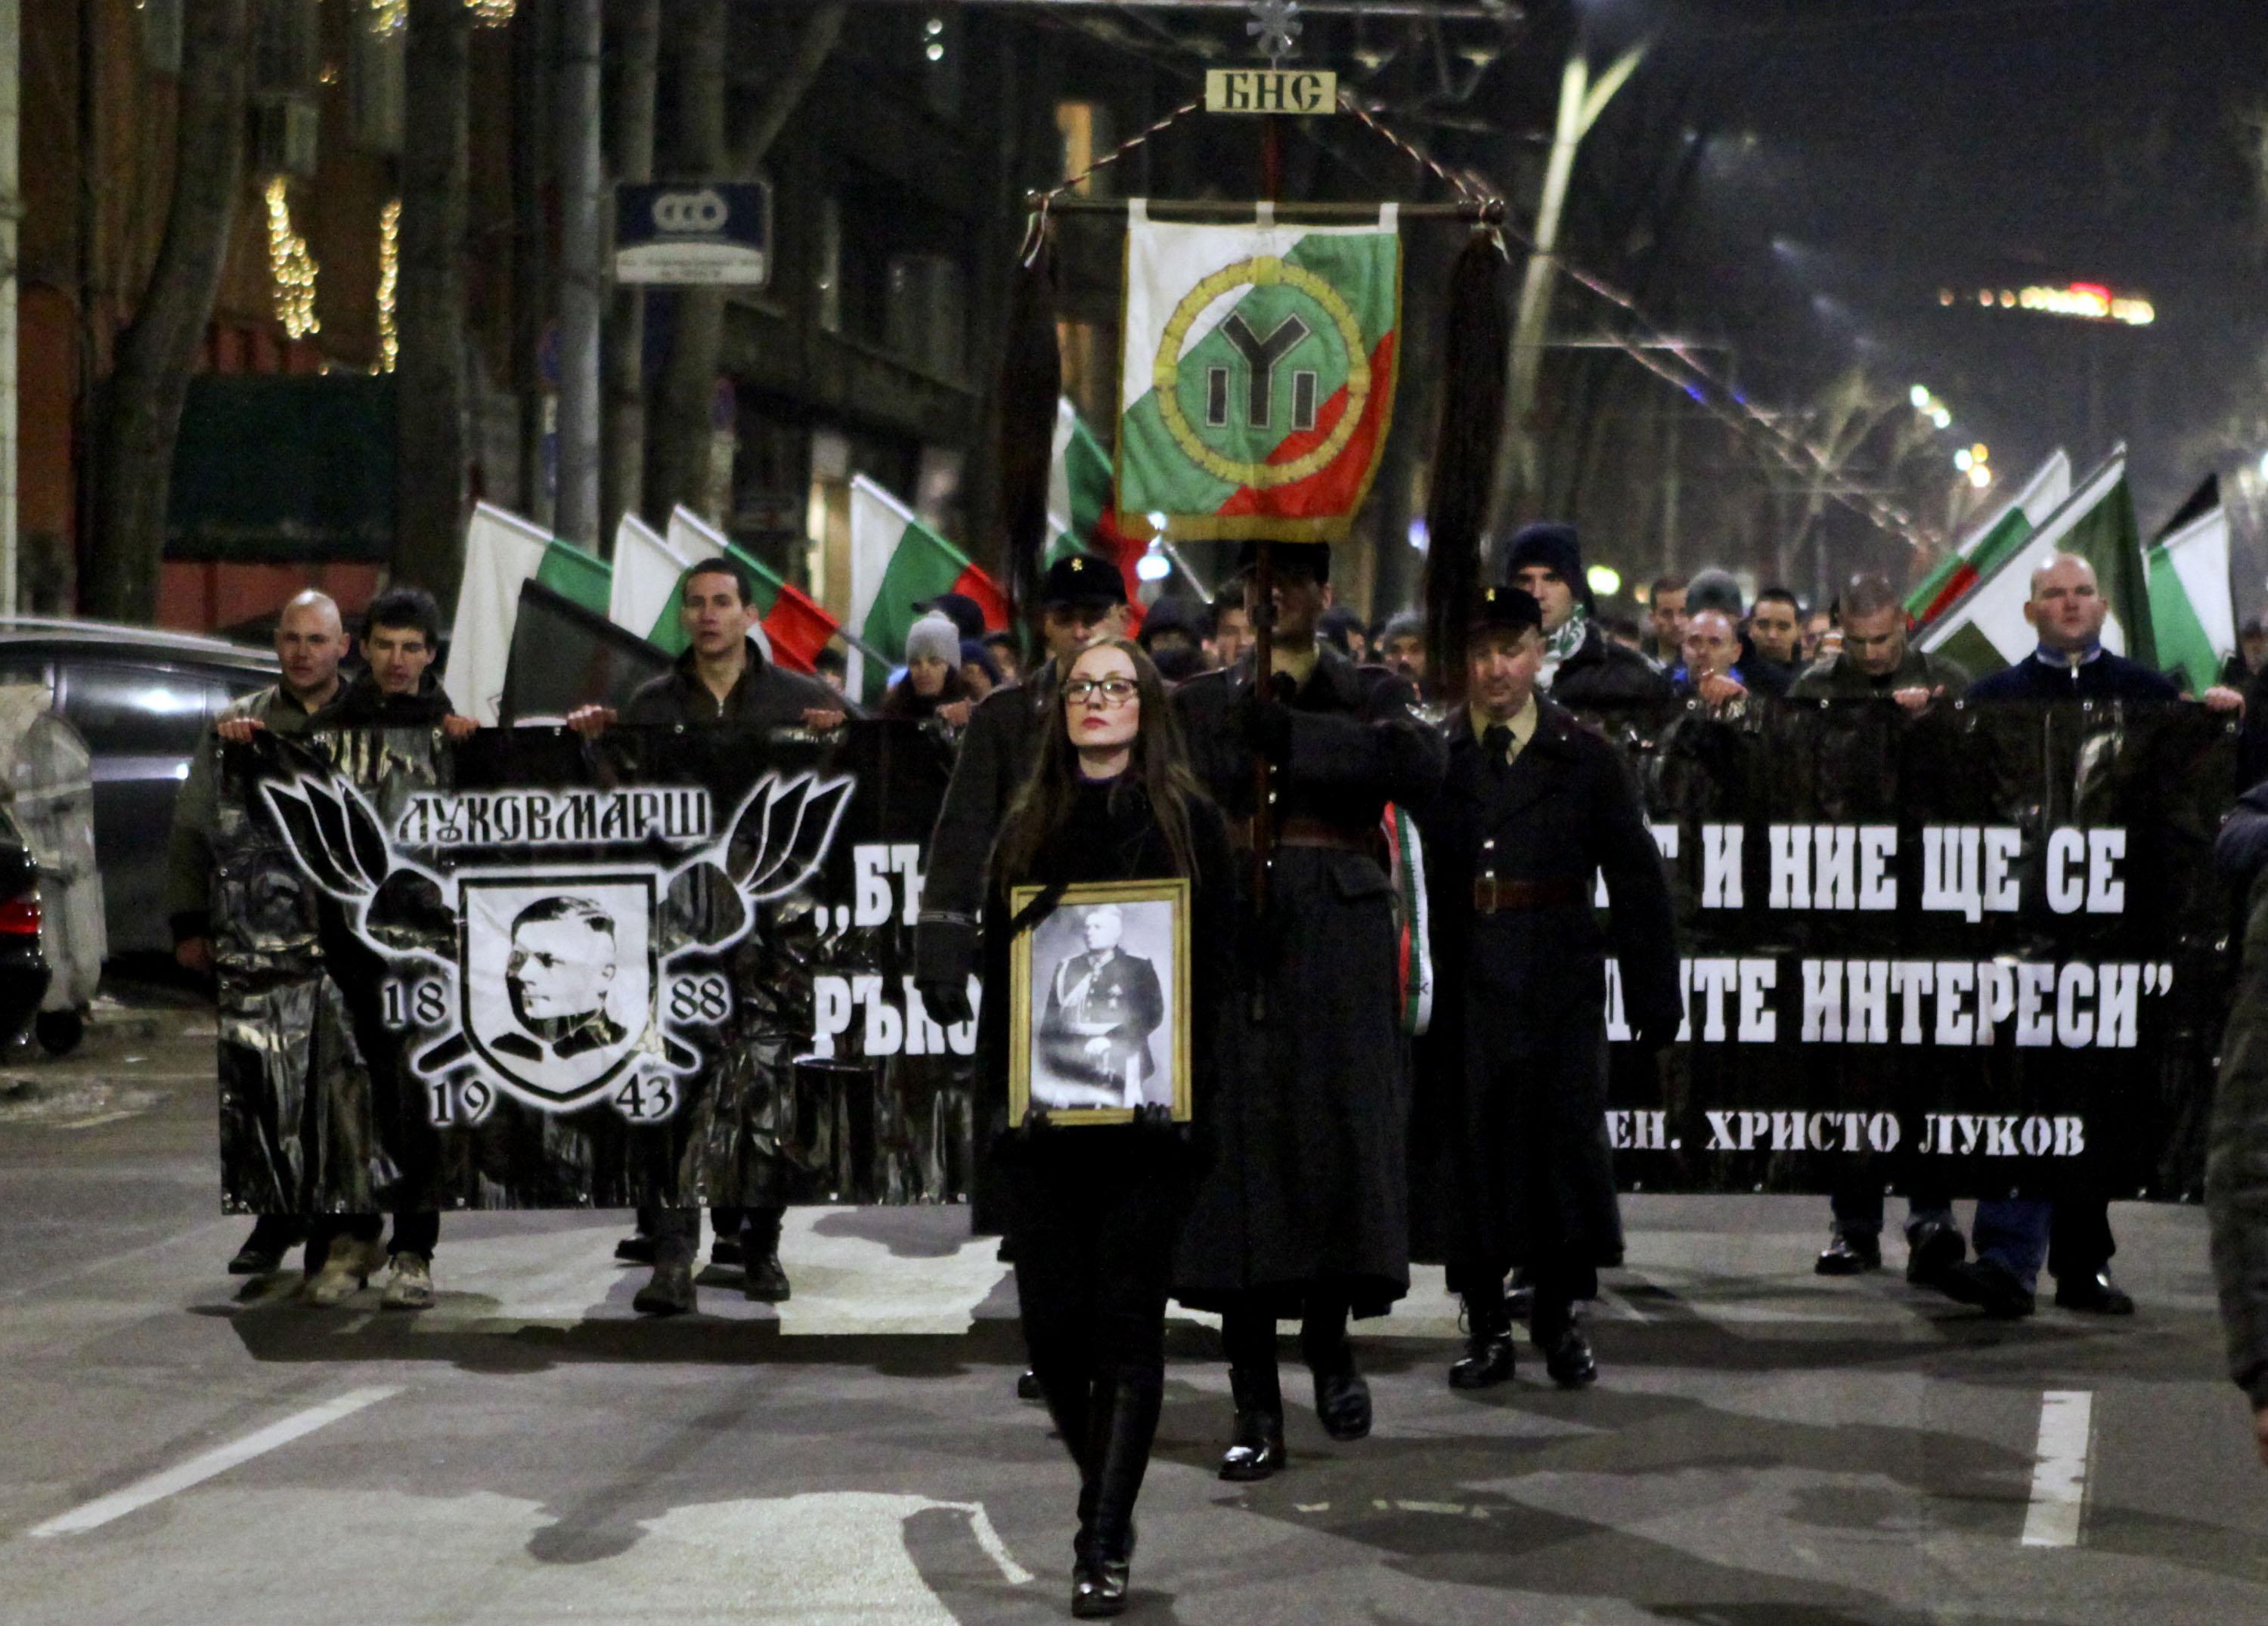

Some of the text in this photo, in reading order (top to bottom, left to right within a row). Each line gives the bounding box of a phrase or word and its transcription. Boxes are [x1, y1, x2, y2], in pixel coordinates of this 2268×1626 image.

[1222, 73, 1322, 111] БНС
[398, 791, 707, 843] ЛУКОВМАРШ
[1702, 824, 1744, 909] И
[1768, 825, 1898, 910] НИЕ
[1921, 825, 2022, 923] ЩЕ
[2046, 826, 2127, 914] СЕ
[384, 977, 728, 1024] 18 88
[1801, 957, 2174, 1048] ИНТЕРЕСИ”
[432, 1072, 674, 1123] 19 43
[1603, 1110, 2085, 1156] ЕН. ХРИСТО ЛУКОВ
